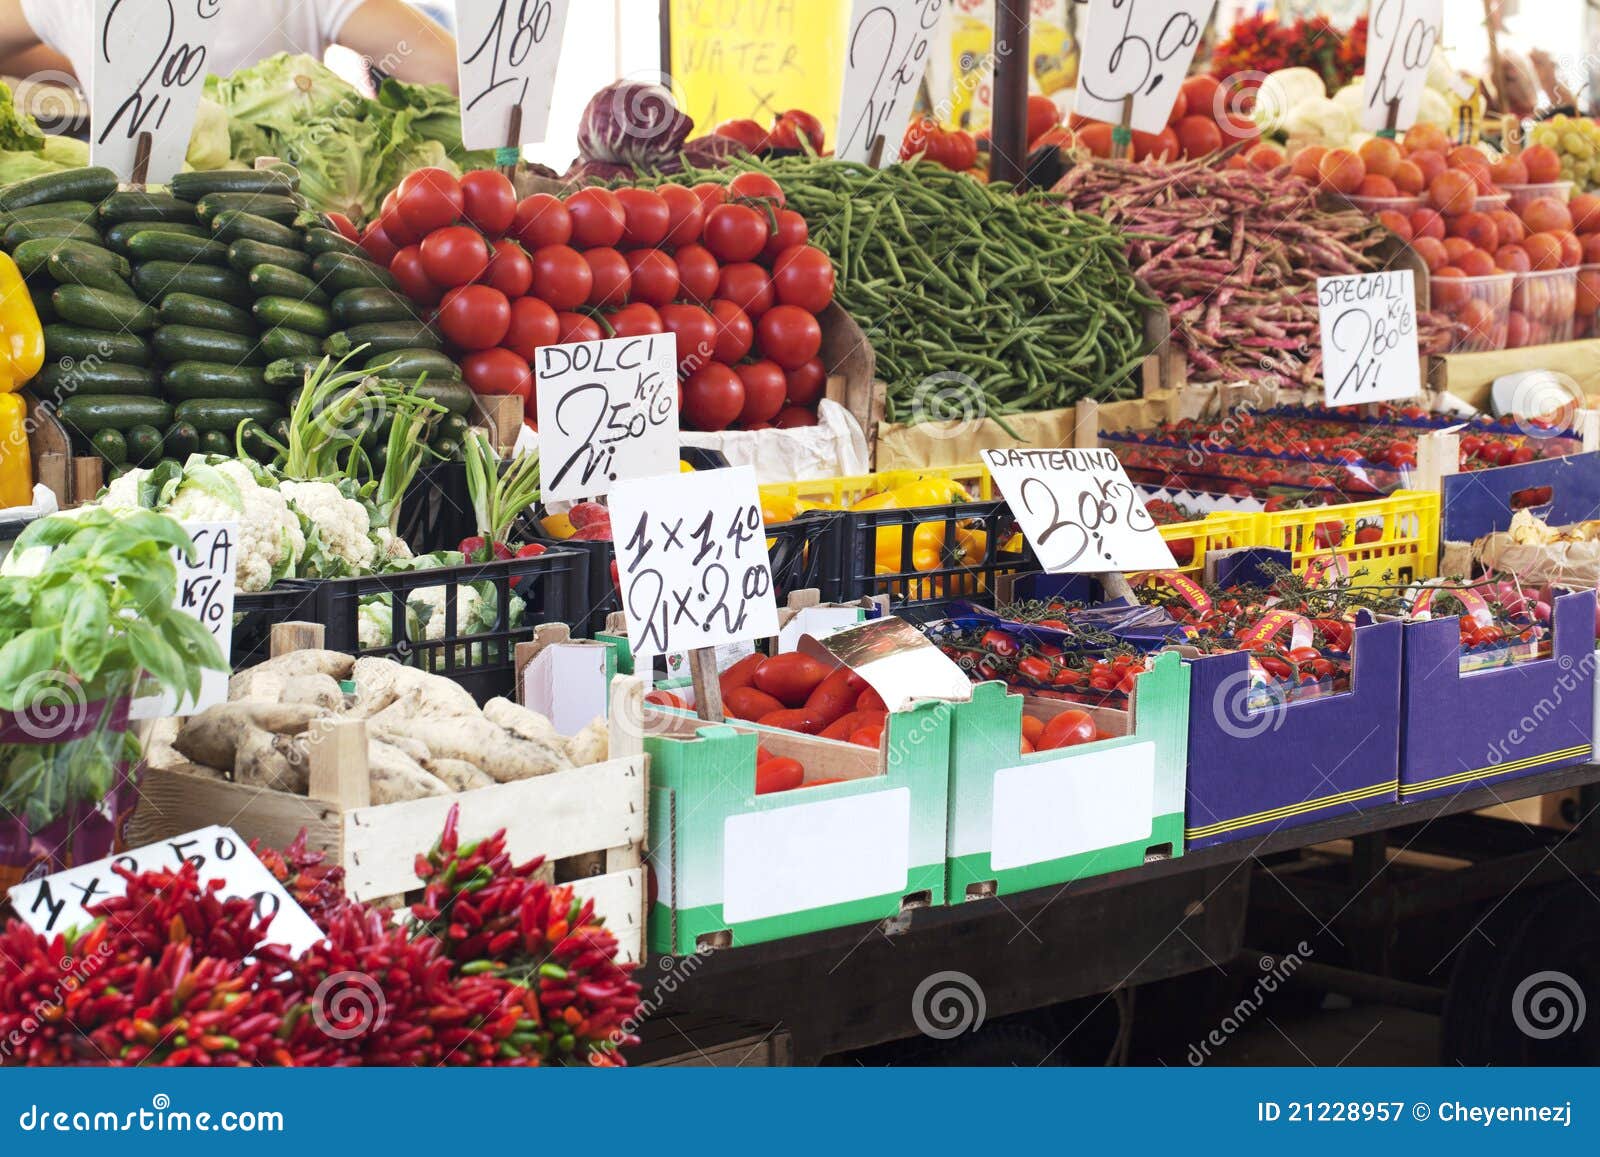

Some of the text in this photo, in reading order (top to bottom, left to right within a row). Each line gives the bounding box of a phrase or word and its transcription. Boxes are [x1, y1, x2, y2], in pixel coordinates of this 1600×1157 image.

[681, 40, 807, 79] WATER
[1320, 272, 1404, 307] SPECIALI
[540, 337, 654, 379] DOLCI
[987, 449, 1119, 472] DATTERINO
